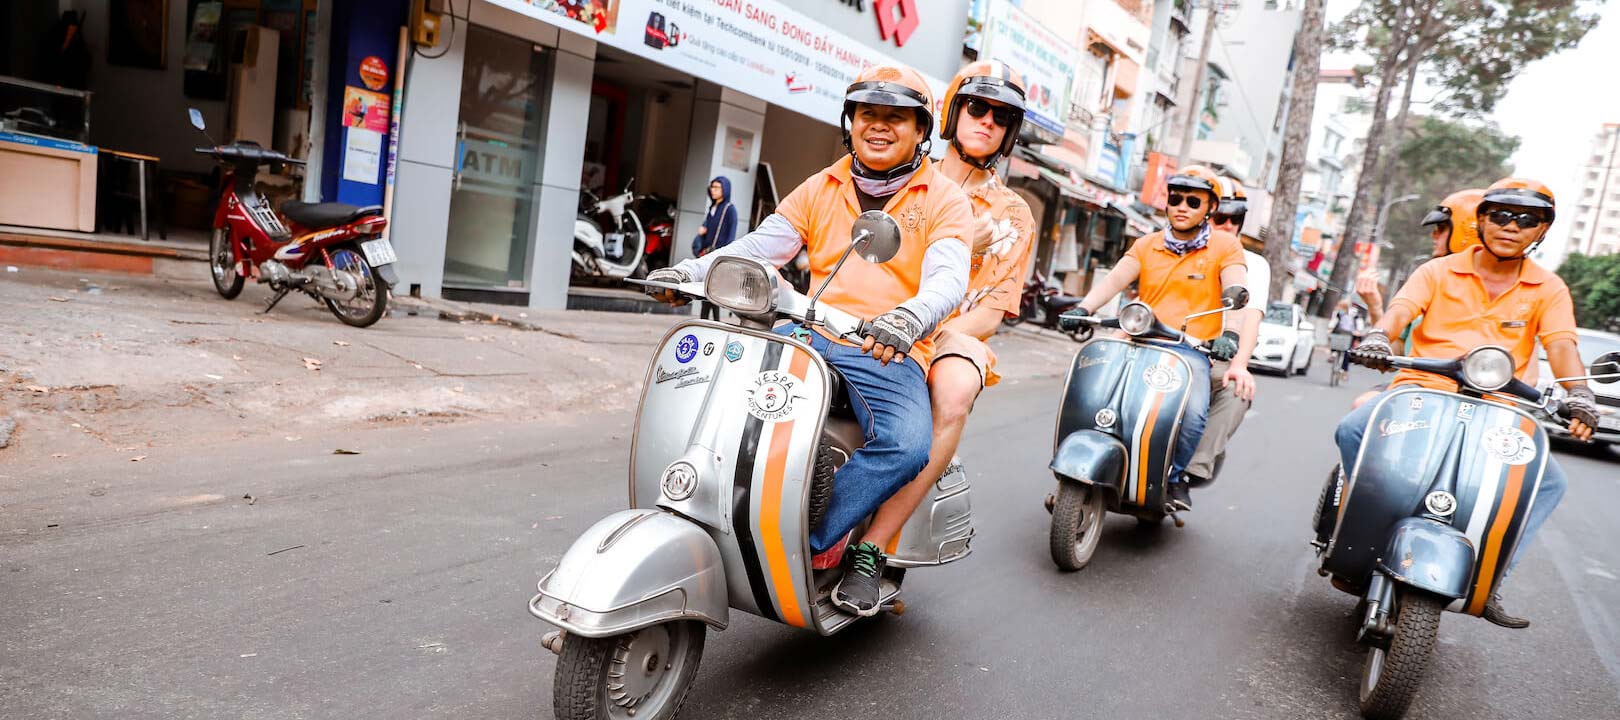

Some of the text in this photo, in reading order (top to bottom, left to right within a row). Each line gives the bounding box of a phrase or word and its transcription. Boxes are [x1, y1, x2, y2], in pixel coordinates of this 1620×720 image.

[717, 16, 766, 46] Techcombank
[745, 3, 778, 33] SANG,
[463, 149, 522, 178] ATM
[755, 372, 794, 391] VESPA
[748, 397, 793, 420] ADVENTURES
